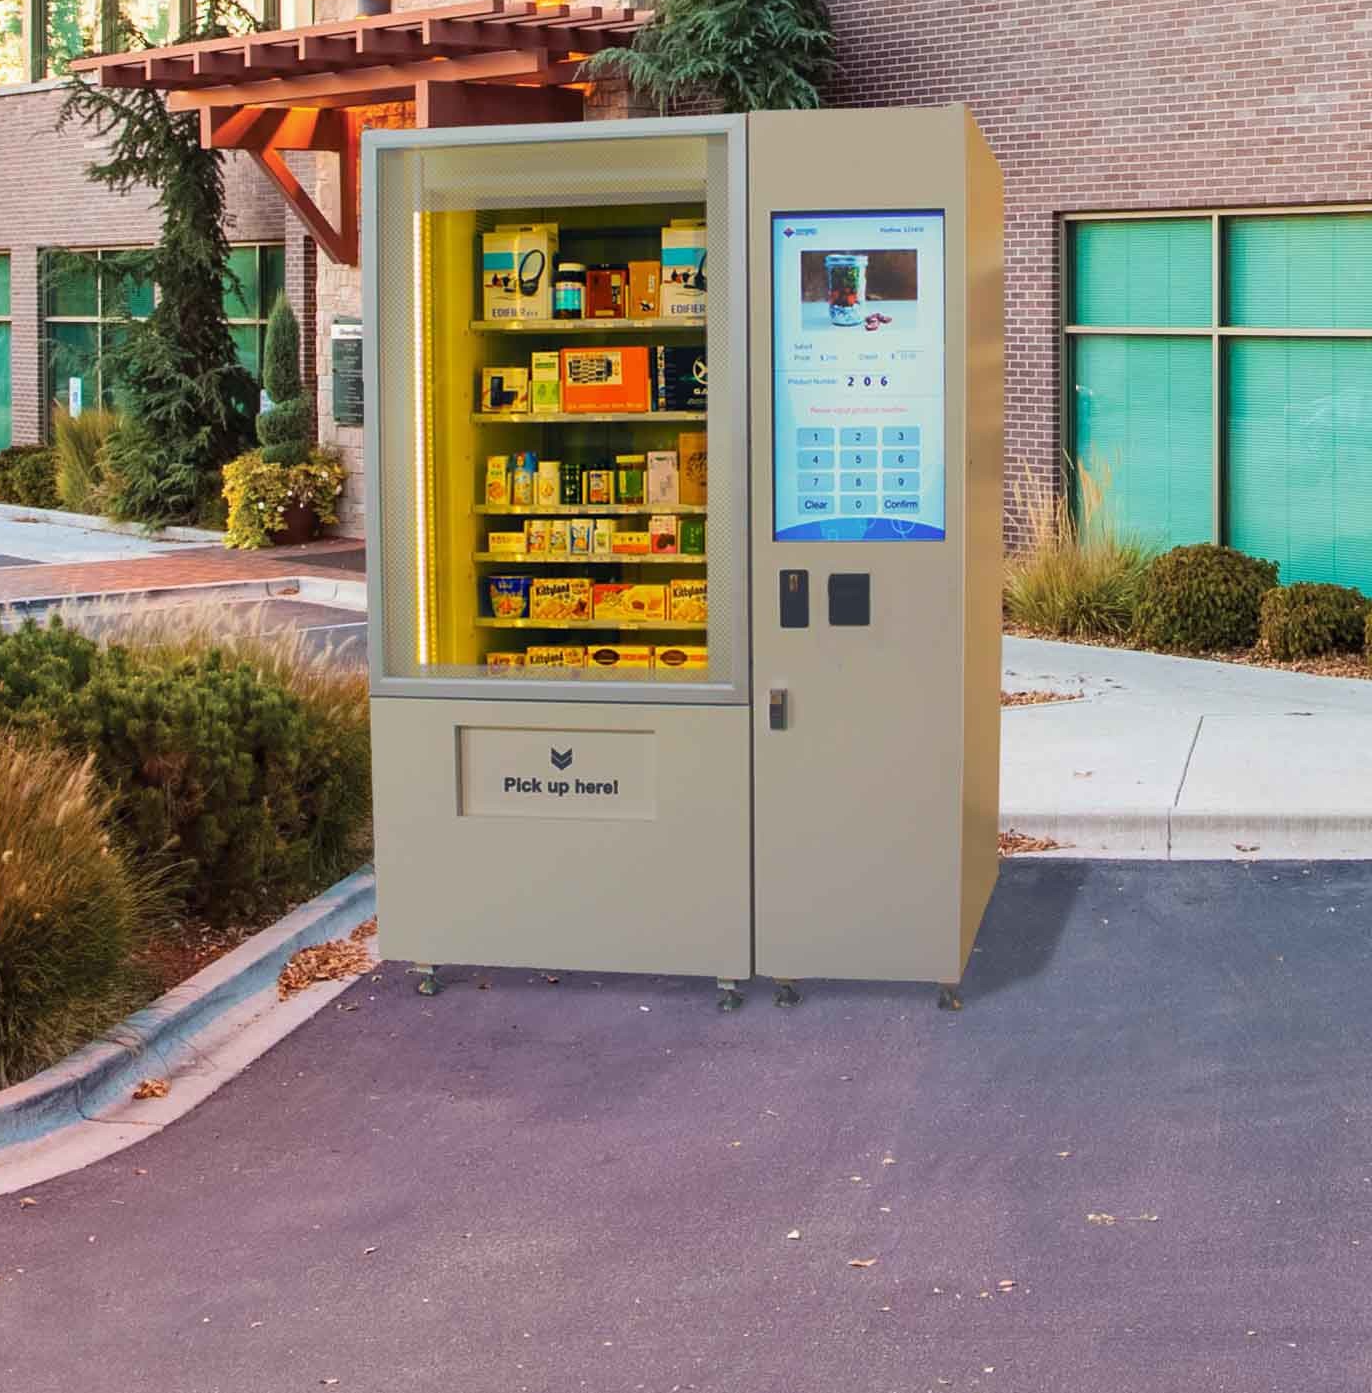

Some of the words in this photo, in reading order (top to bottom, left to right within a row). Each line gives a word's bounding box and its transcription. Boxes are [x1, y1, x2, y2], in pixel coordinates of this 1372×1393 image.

[847, 377, 854, 387] 2
[864, 376, 871, 386] 0
[881, 376, 888, 386] 6
[804, 499, 828, 509] Clear
[884, 499, 918, 509] Confirm
[504, 778, 542, 792] Pick
[548, 781, 569, 796] up
[575, 779, 618, 794] here!
